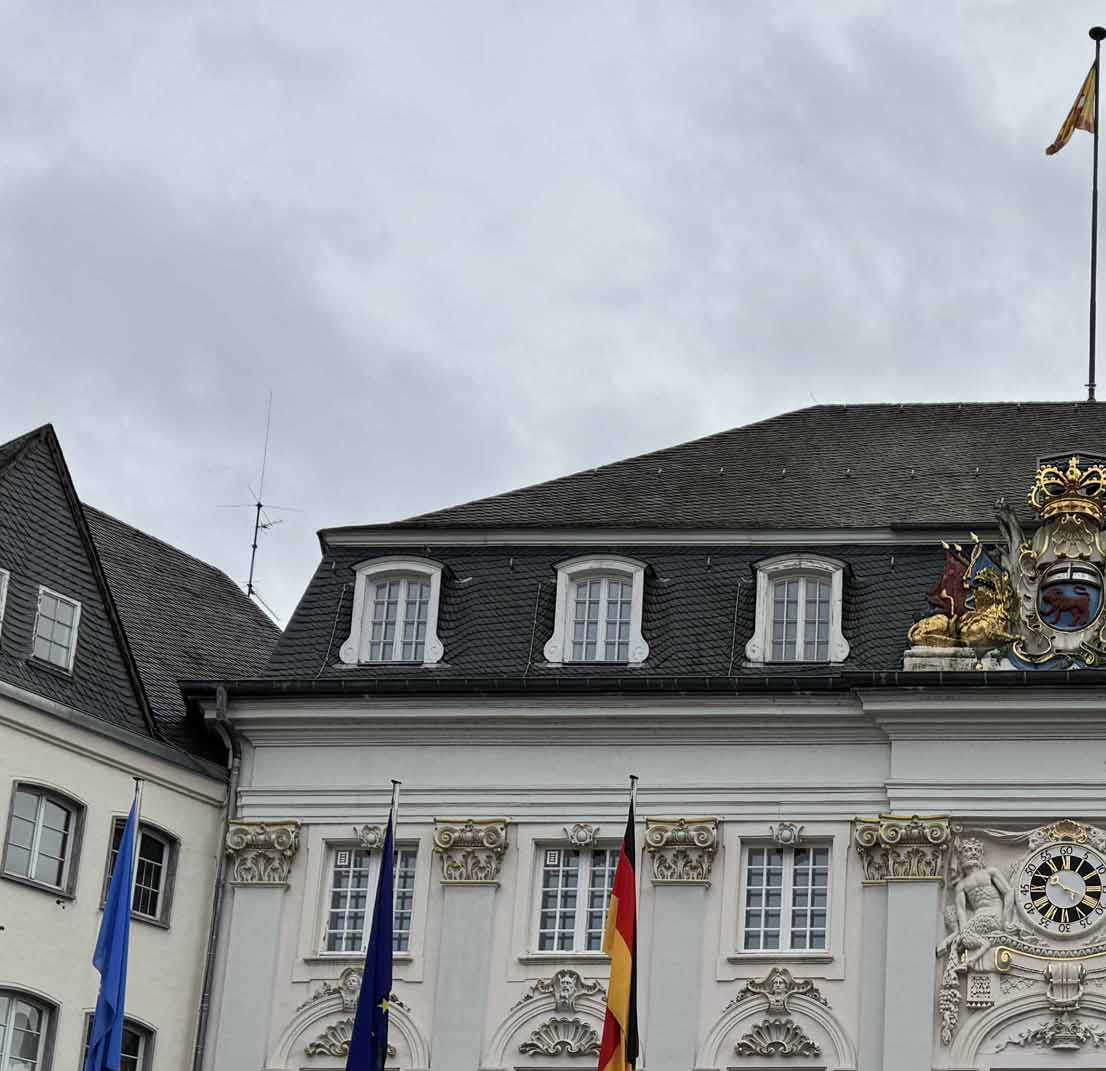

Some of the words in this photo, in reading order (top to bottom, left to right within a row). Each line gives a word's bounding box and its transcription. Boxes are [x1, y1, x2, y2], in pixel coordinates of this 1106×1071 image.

[1040, 850, 1052, 862] 55
[1025, 864, 1036, 876] 50
[1020, 884, 1029, 896] 45
[1024, 902, 1035, 914] 40
[1038, 918, 1052, 928] 35
[1058, 924, 1071, 932] 30
[1080, 916, 1092, 928] 25
